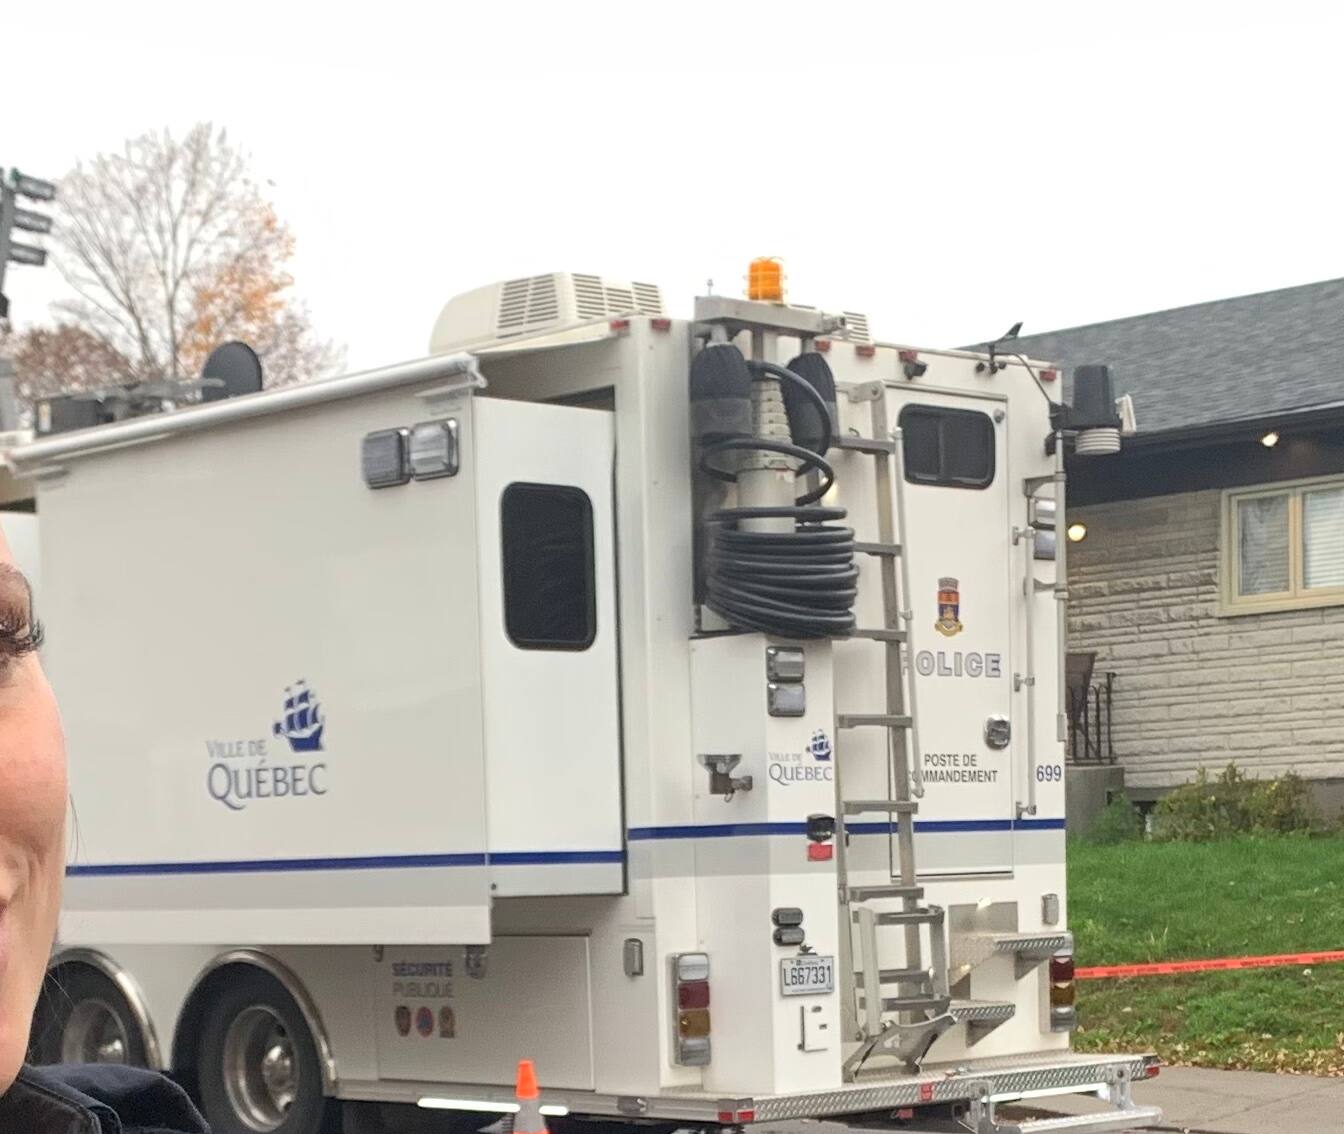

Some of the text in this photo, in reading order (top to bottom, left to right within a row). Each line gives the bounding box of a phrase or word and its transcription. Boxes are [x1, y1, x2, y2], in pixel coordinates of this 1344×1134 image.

[206, 739, 267, 758] VILLE DE
[924, 753, 977, 767] POSTE DE
[1036, 764, 1062, 782] 699
[207, 759, 328, 810] QUÉBEC
[783, 965, 831, 986] L667331
